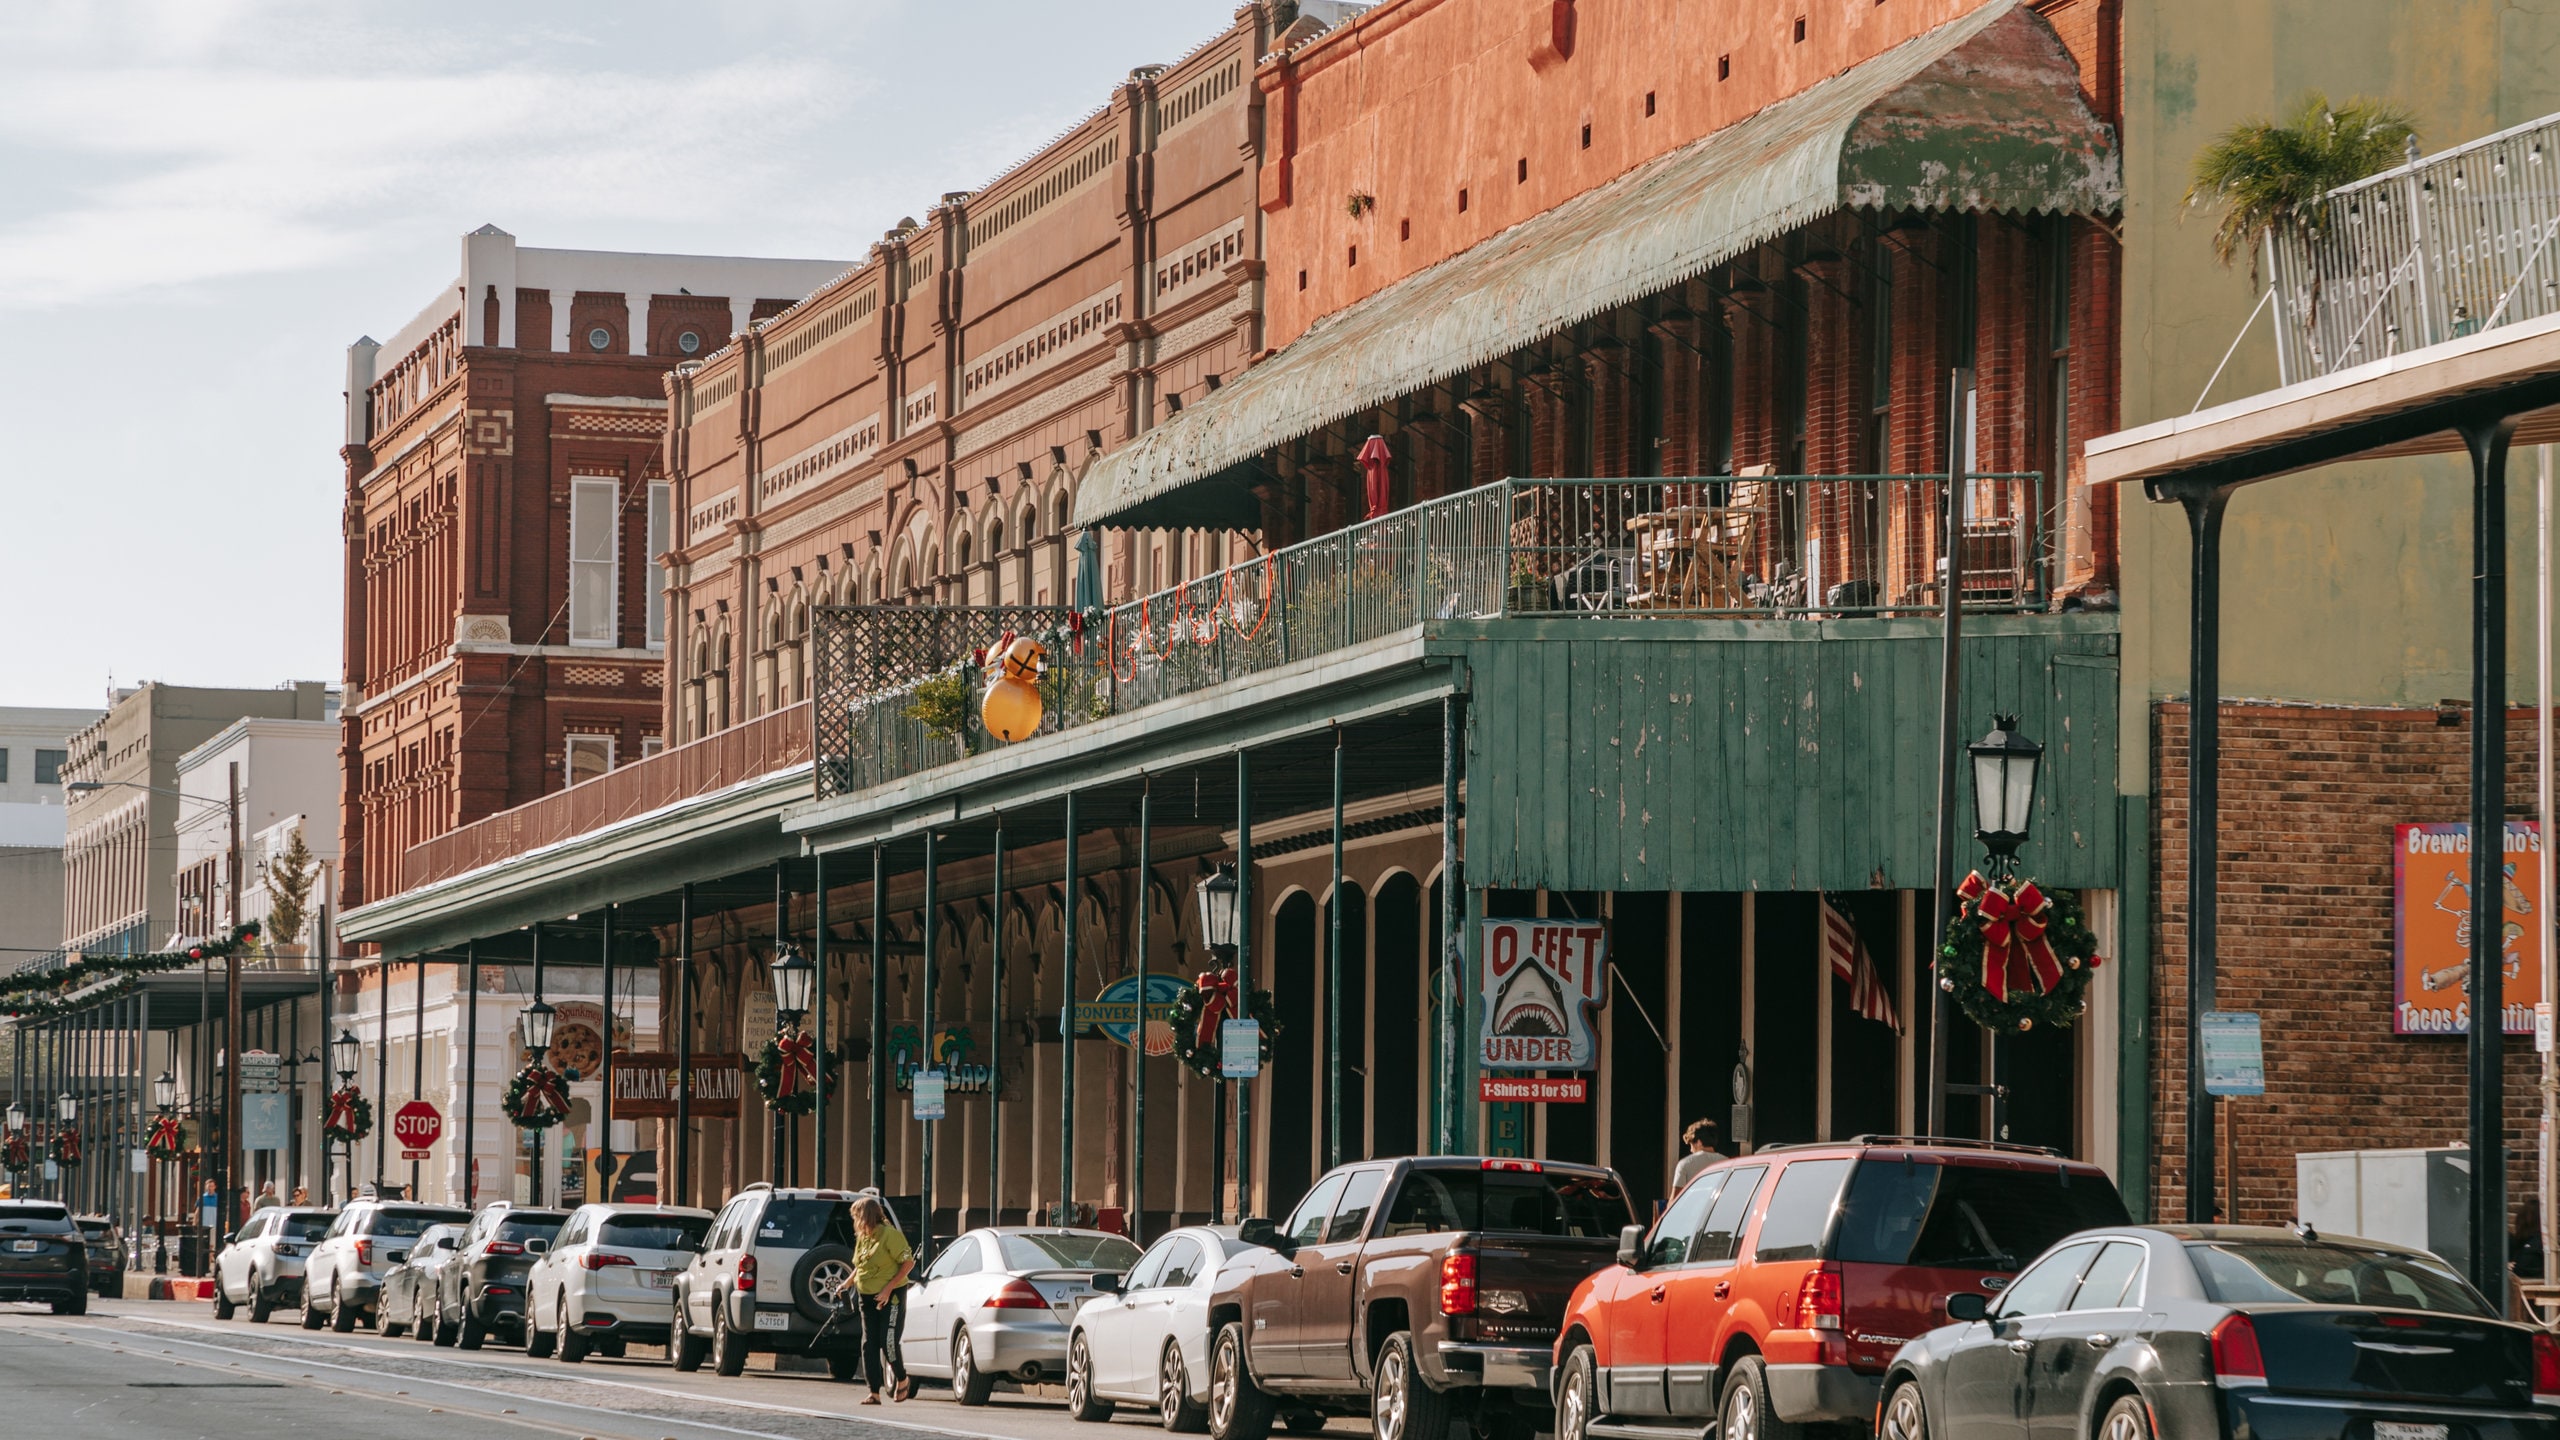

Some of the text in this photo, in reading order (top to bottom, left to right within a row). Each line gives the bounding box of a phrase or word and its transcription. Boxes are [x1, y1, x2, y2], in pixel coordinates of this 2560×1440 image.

[1532, 926, 1603, 999] FEET
[2398, 1001, 2452, 1032] Tacos
[2455, 1001, 2471, 1032] &
[1485, 1038, 1573, 1062] UNDER
[615, 1067, 741, 1100] PELICAN ISLAND
[1483, 1083, 1582, 1098] T-Shirts 3 for $10
[396, 1115, 440, 1135] STOP
